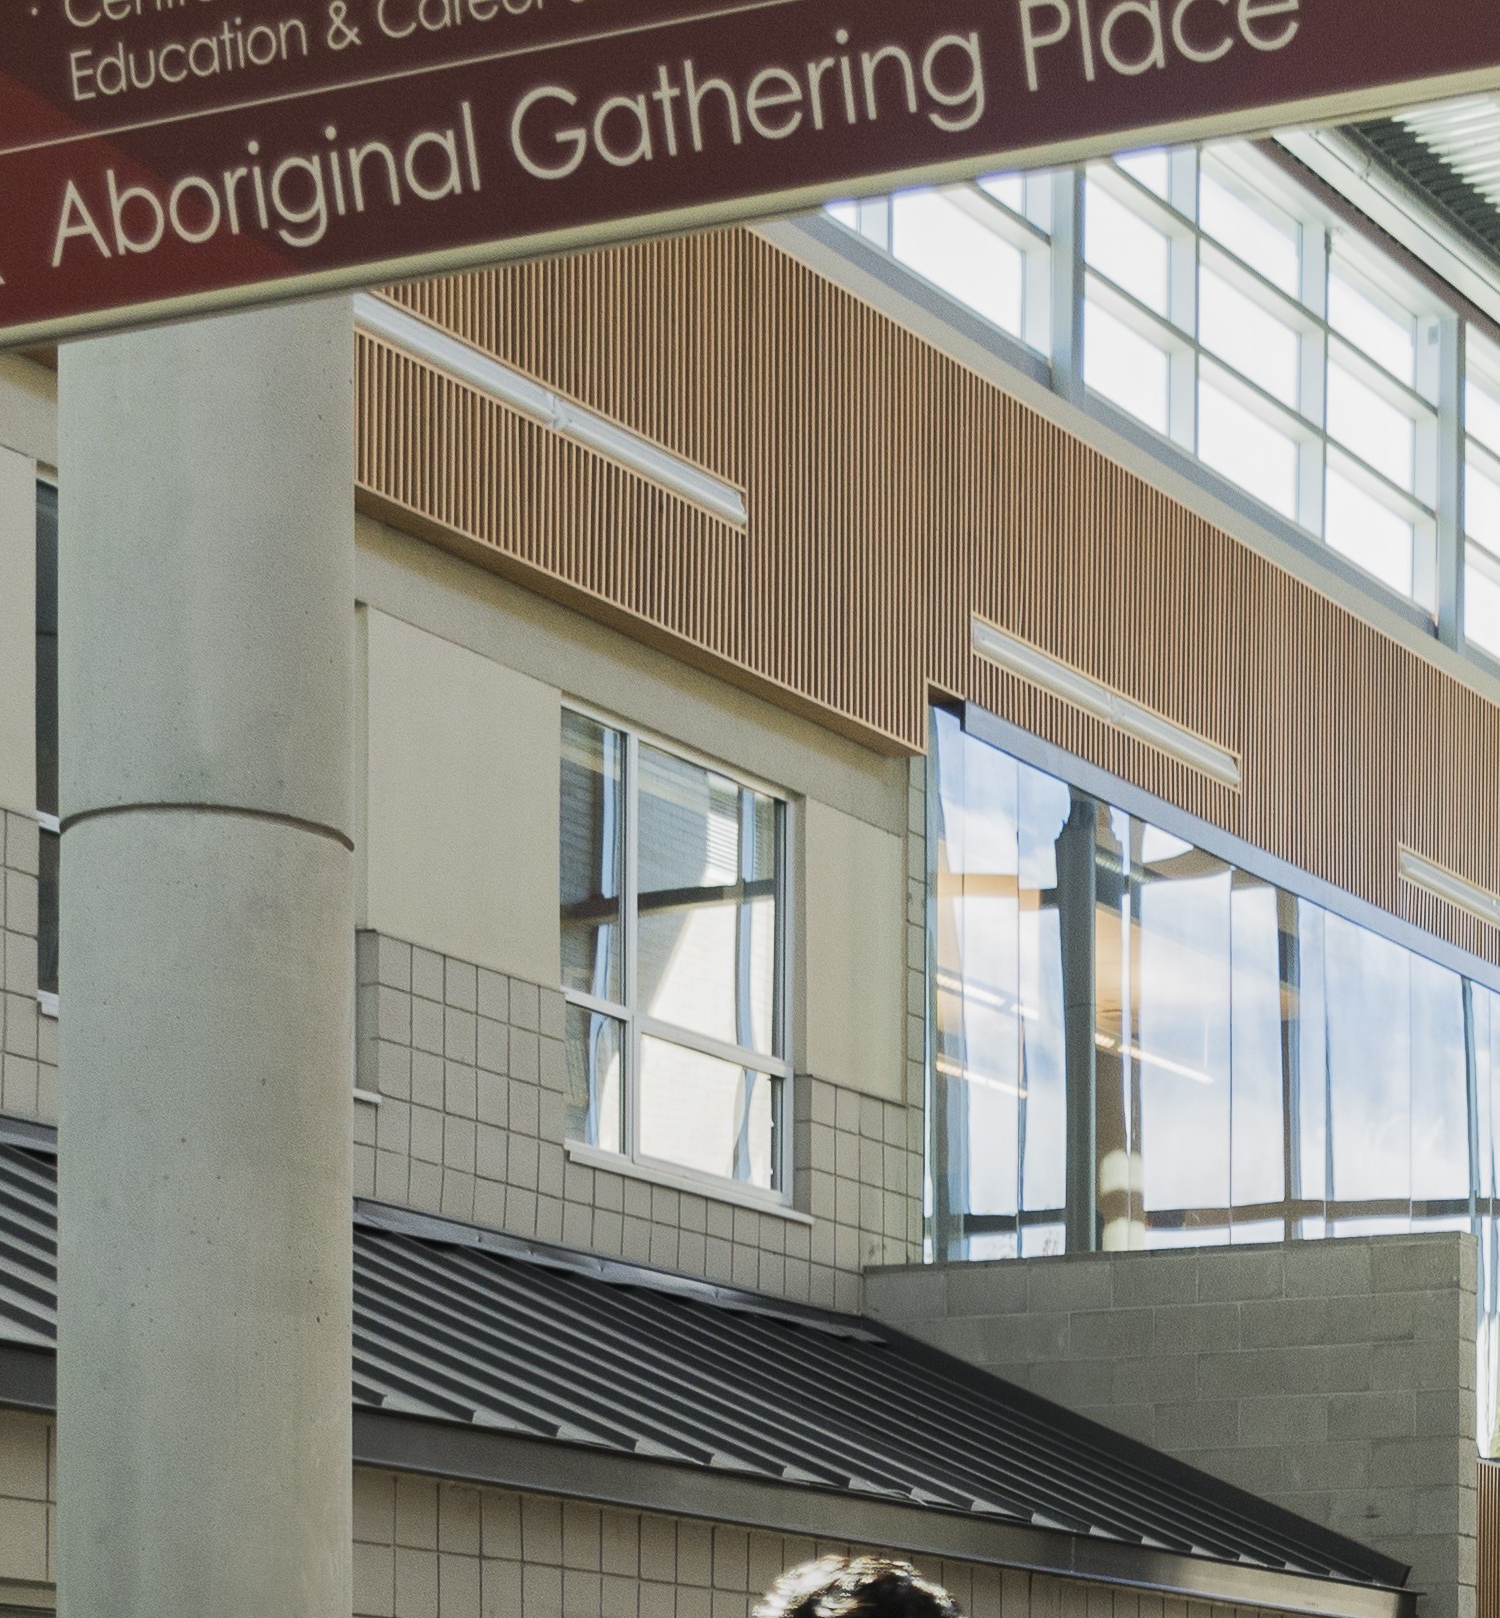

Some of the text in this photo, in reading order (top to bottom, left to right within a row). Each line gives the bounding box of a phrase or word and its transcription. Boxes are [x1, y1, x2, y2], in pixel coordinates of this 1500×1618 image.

[51, 0, 1300, 267] Aboriginal Gathering Place
[69, 0, 544, 101] Education & Care
